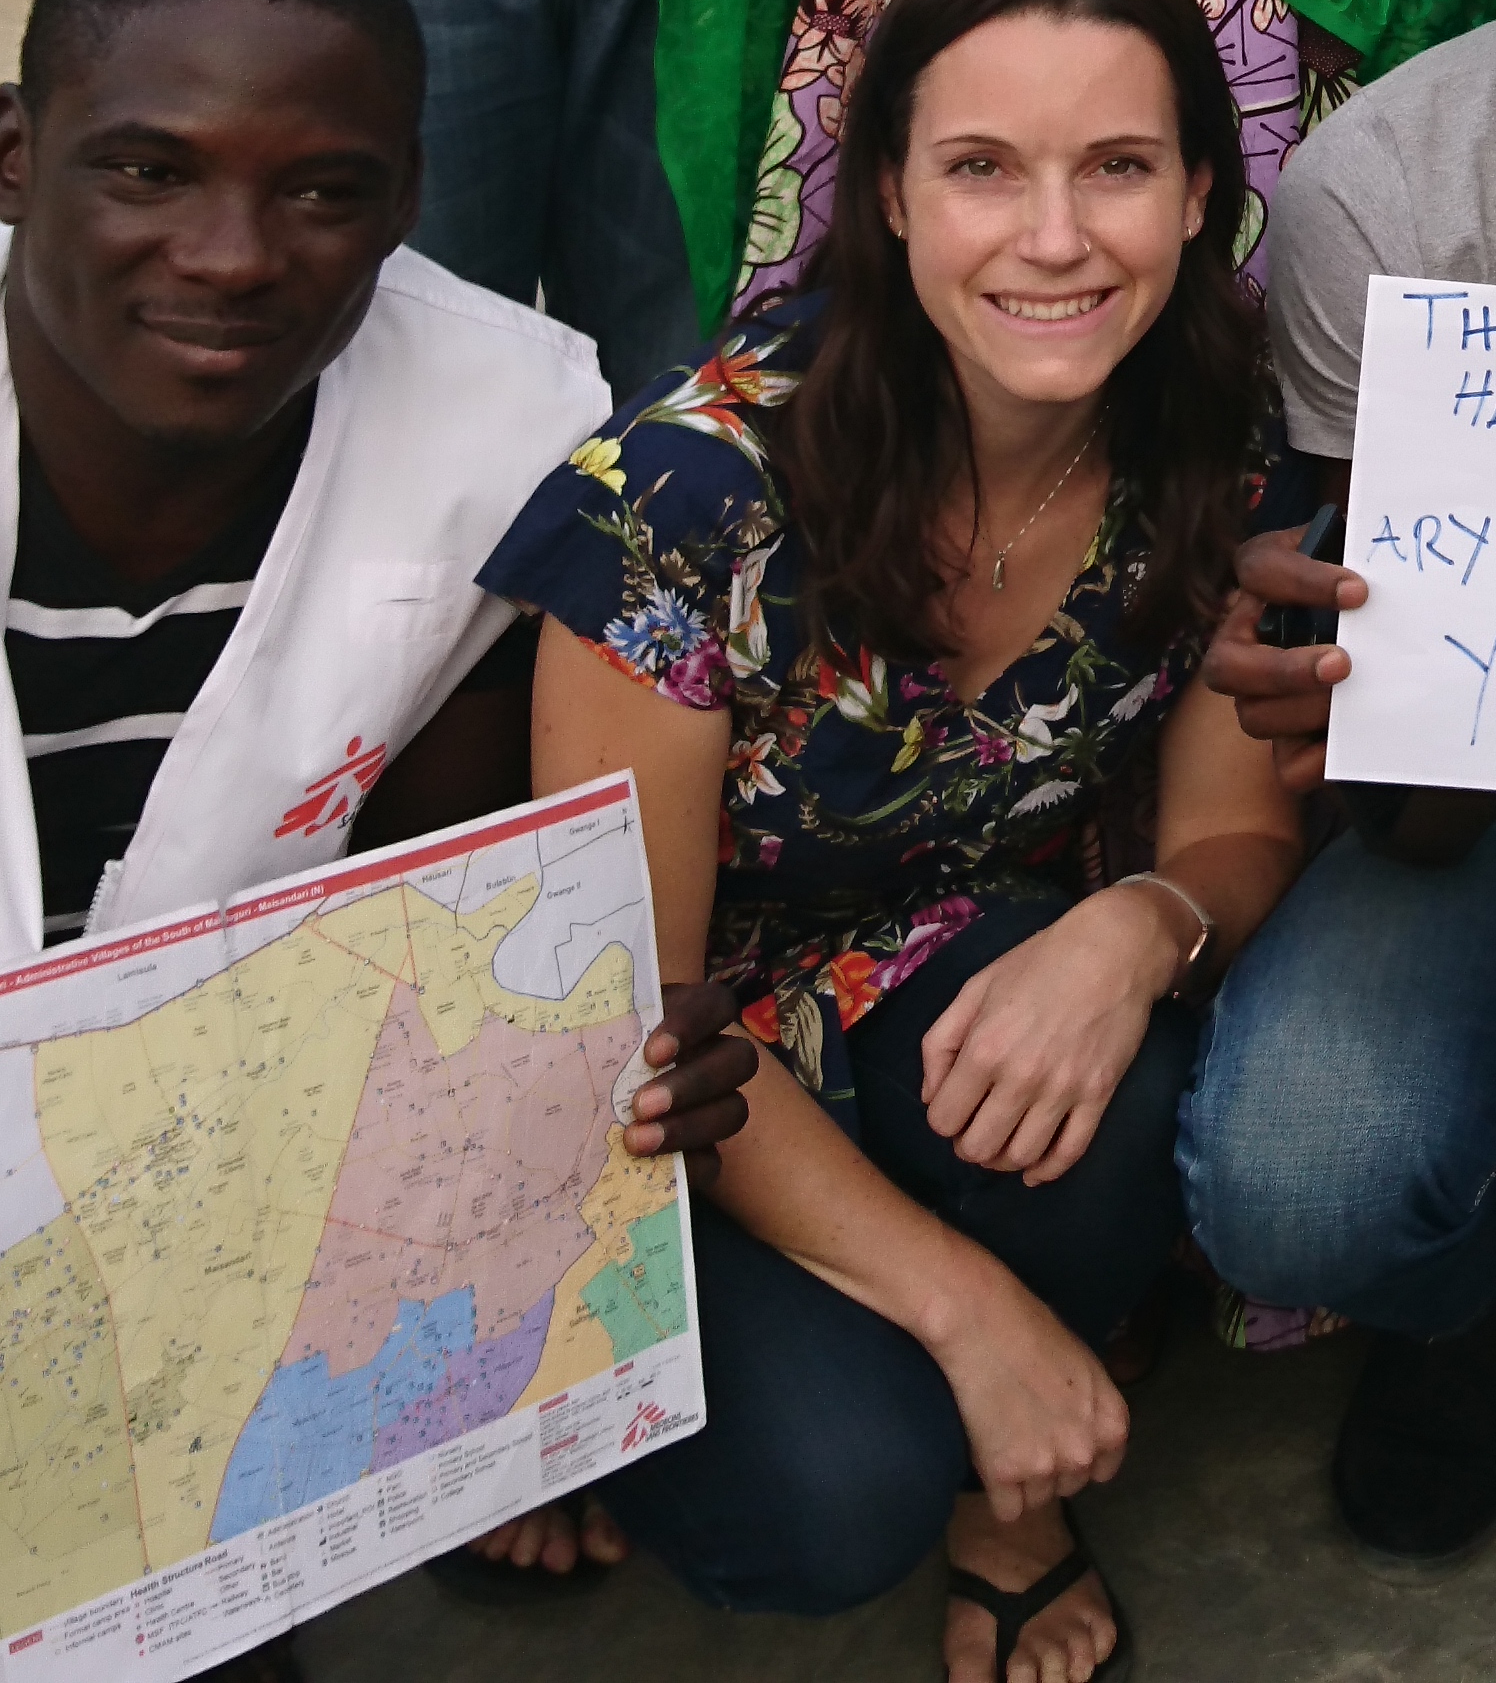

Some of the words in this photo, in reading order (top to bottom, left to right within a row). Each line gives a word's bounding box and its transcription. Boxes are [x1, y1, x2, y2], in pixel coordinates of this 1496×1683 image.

[1370, 514, 1492, 586] ARY
[569, 822, 596, 836] Gwange
[422, 868, 452, 884] Hausari
[547, 885, 576, 900] Gwange
[14, 954, 89, 984] Administrative
[89, 940, 132, 961] Villages
[131, 937, 144, 949] of
[142, 932, 160, 945] the
[160, 922, 191, 940] South
[191, 919, 203, 931] of
[256, 887, 309, 911] Maisandari
[308, 882, 324, 896] (N)
[117, 963, 157, 981] Lamisula
